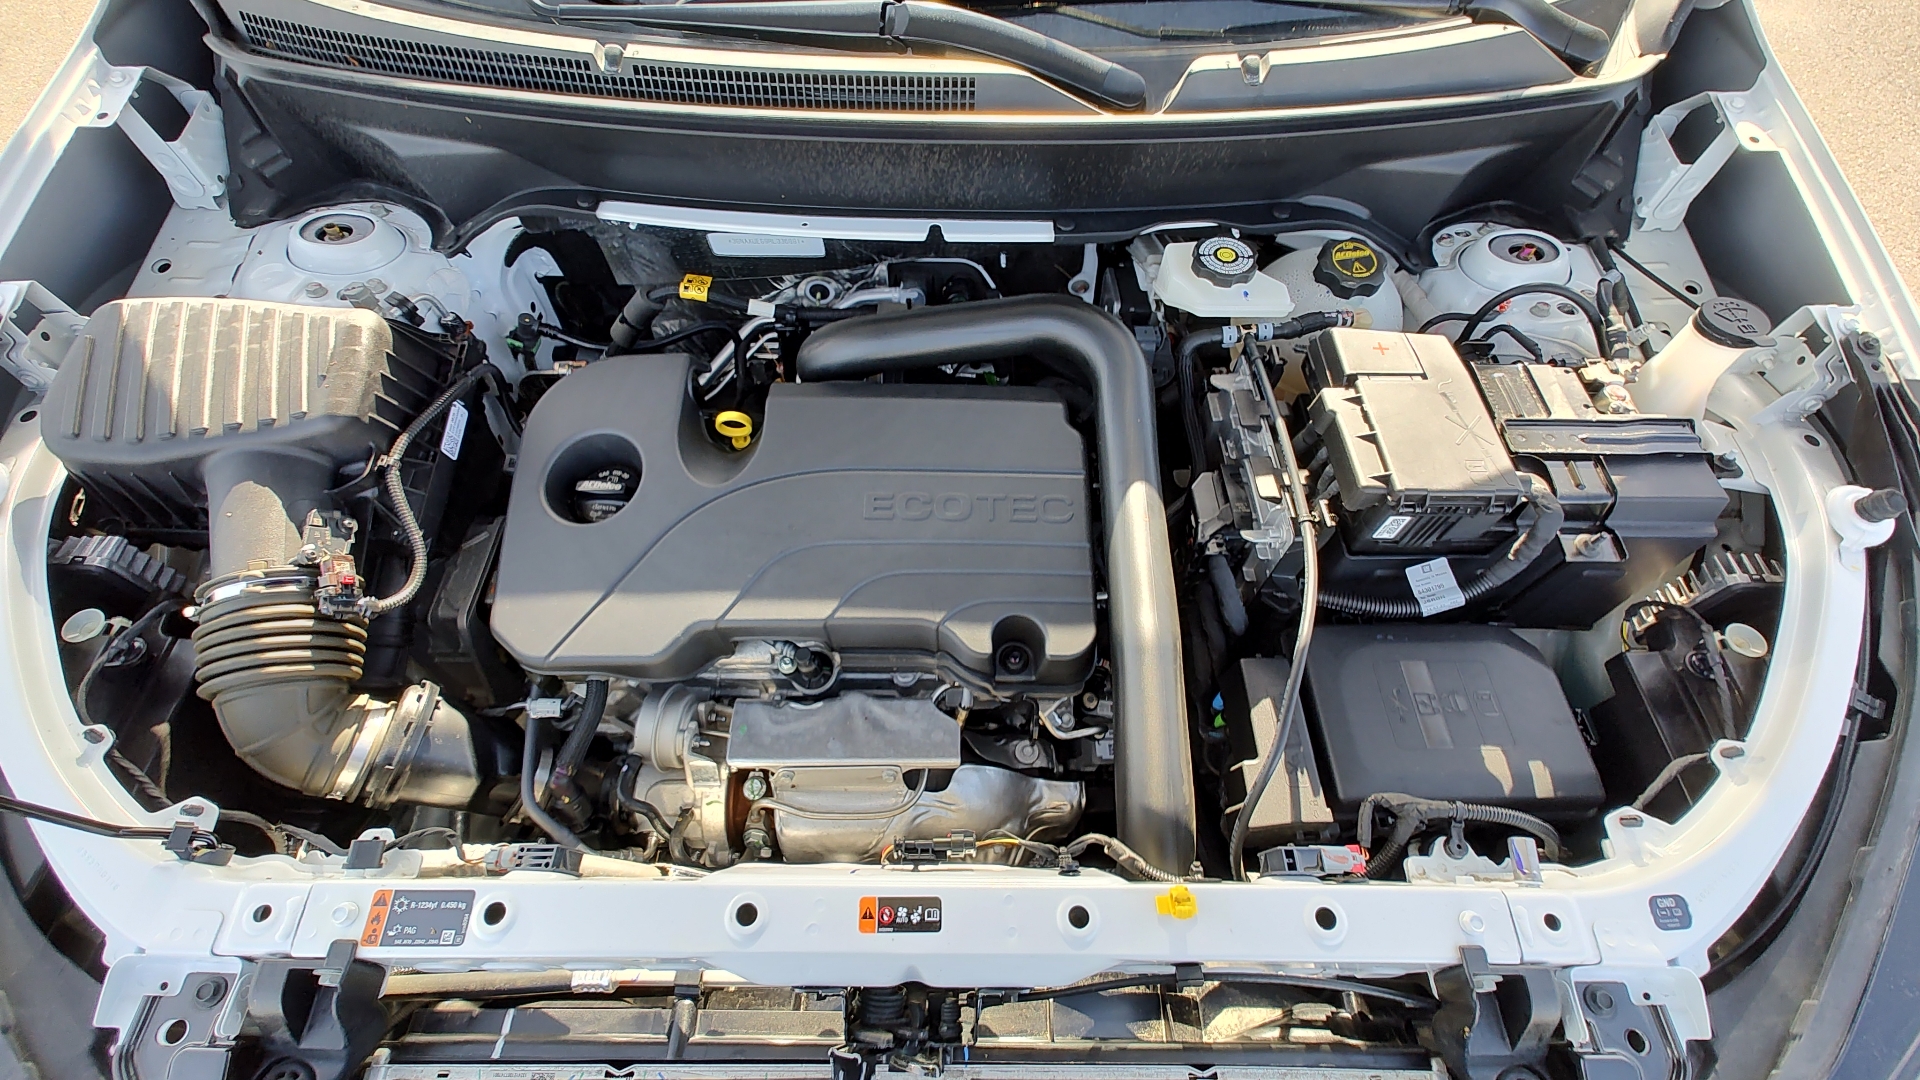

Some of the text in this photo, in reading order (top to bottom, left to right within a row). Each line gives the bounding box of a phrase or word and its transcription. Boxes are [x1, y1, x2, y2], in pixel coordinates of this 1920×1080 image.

[1335, 249, 1370, 260] ACDelco
[578, 480, 622, 491] ACDelco
[864, 492, 1075, 524] ECOTEC
[410, 901, 467, 911] R-1234yf 0.450 kg
[1656, 897, 1676, 908] GND
[895, 916, 909, 924] AUTO
[403, 926, 417, 935] PAG
